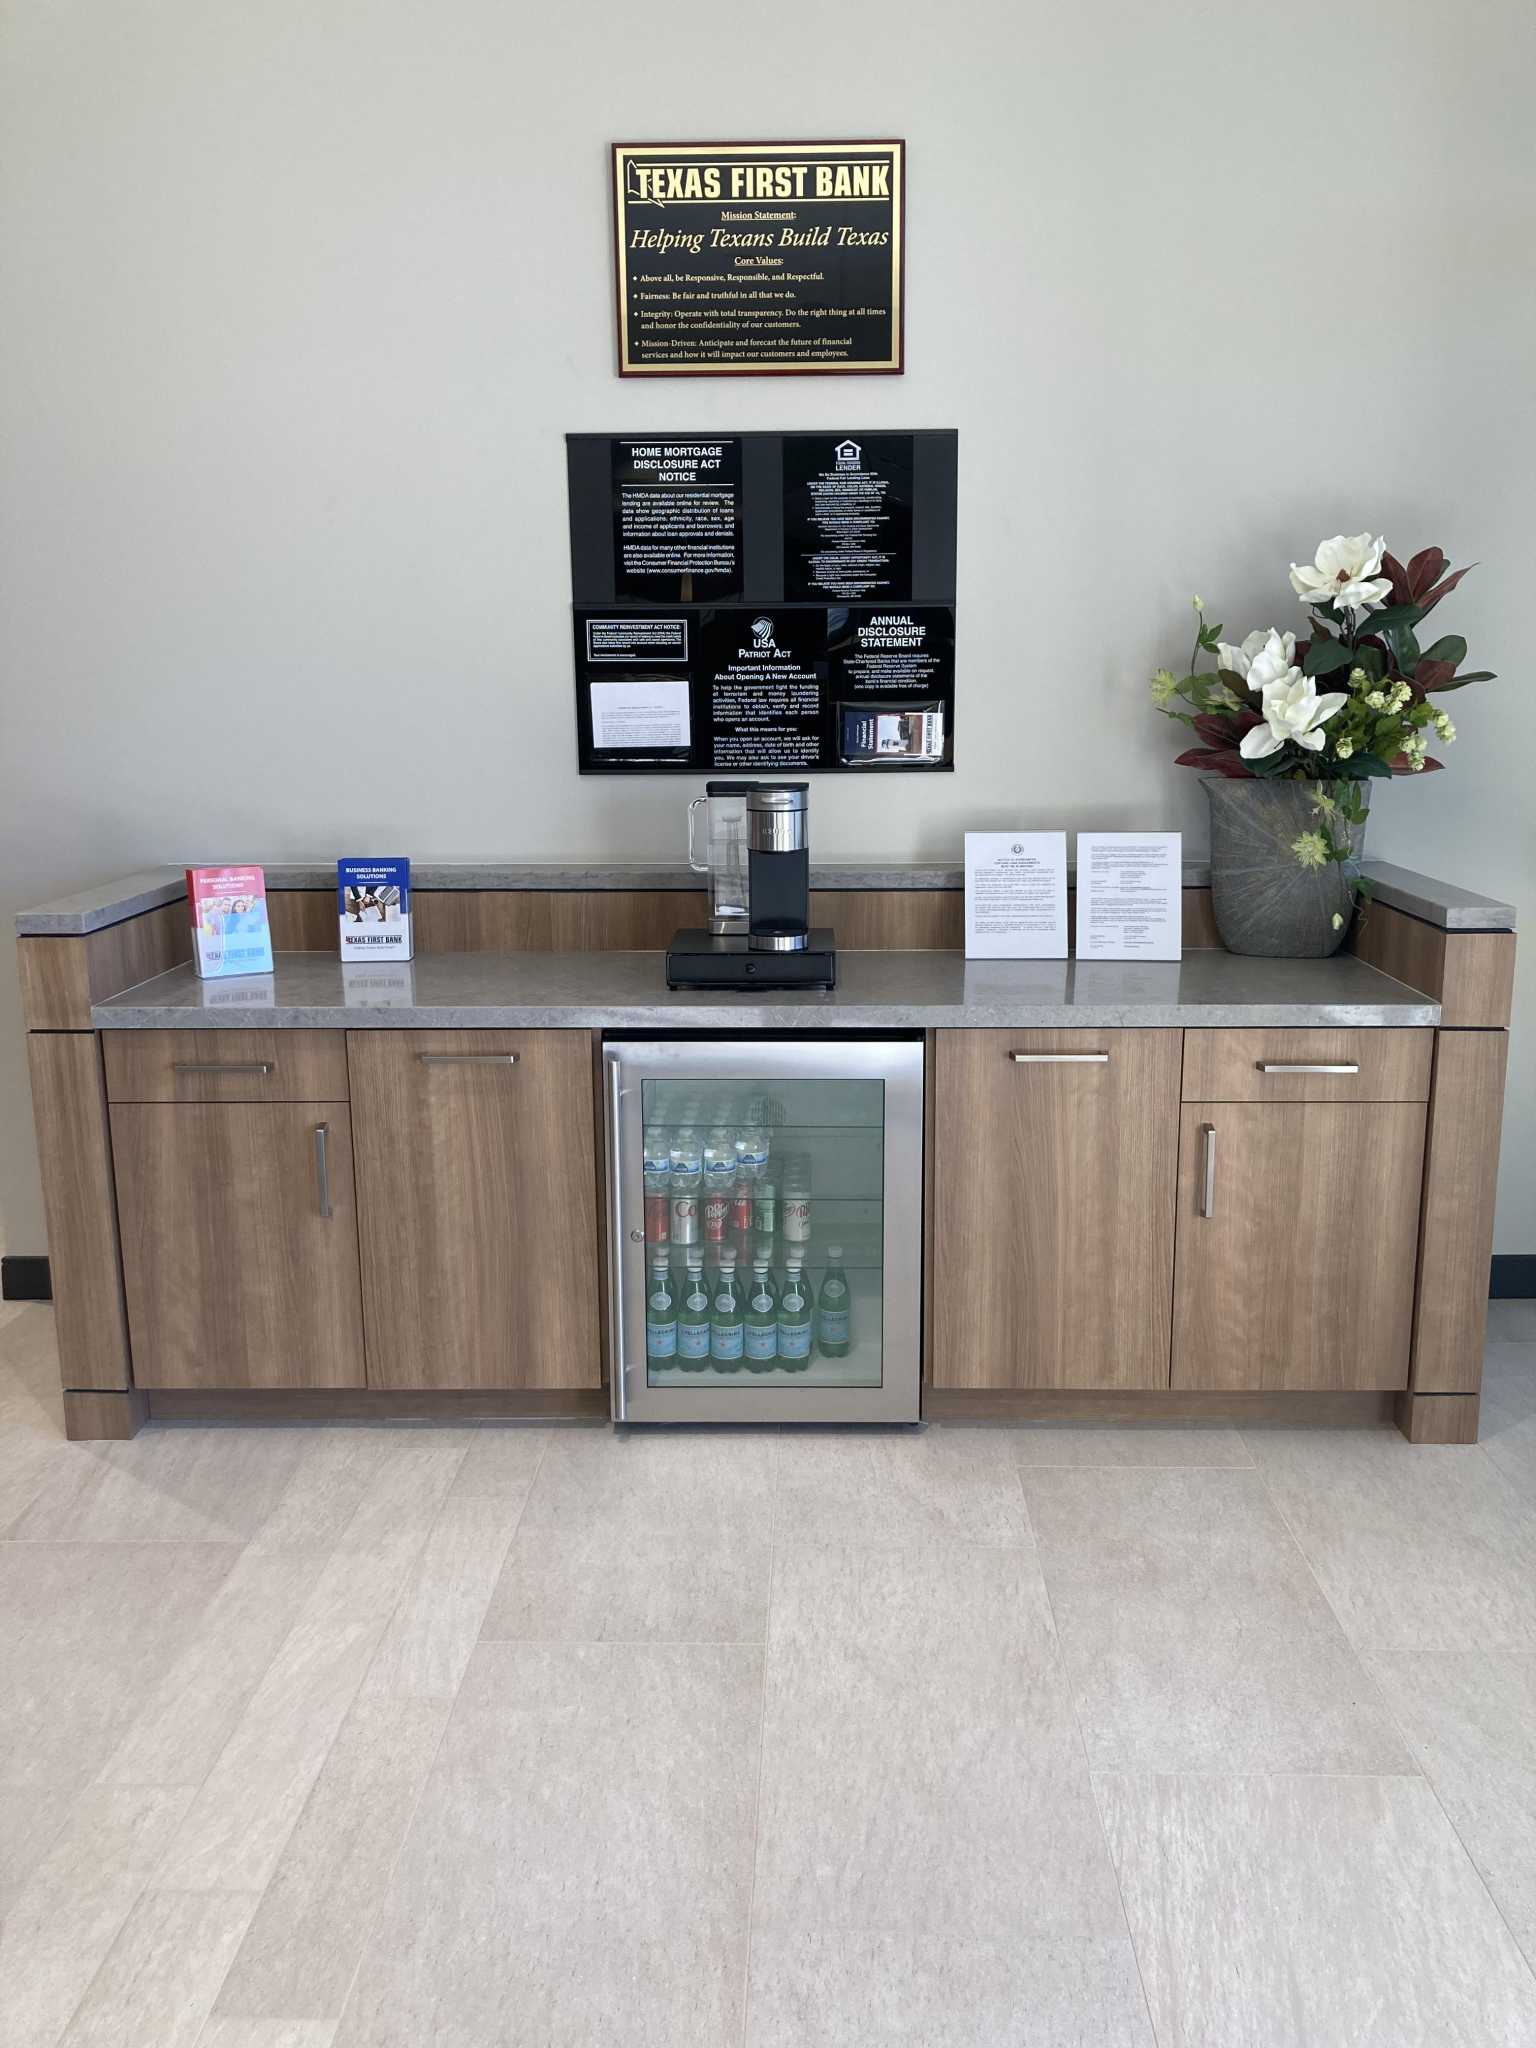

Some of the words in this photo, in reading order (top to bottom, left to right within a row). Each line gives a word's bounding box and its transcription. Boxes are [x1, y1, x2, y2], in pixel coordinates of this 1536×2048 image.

[636, 168, 720, 198] TEXAS
[731, 167, 808, 198] FIRST
[816, 166, 890, 197] BANK
[721, 211, 752, 220] Mission
[754, 211, 796, 220] Statement:
[630, 229, 704, 253] Helping
[710, 228, 773, 248] Texans
[778, 227, 830, 246] Build
[837, 226, 888, 246] Texas
[756, 256, 783, 264] Values:
[685, 274, 725, 282] Responsive,
[727, 273, 770, 282] Responsible,
[786, 272, 824, 282] Respectful.
[674, 310, 701, 319] Operate
[737, 310, 783, 318] transparency.
[810, 308, 826, 317] right
[828, 308, 847, 317] thing
[690, 321, 740, 330] confidentiality
[698, 339, 734, 347] Anticipate
[811, 350, 848, 358] employees.
[632, 448, 661, 456] HOME
[664, 447, 721, 456] MORTGAGE
[634, 460, 697, 468] DISCLOSURE
[700, 459, 720, 468] ACT
[659, 472, 696, 481] NOTICE
[870, 616, 914, 626] ANNUAL
[858, 627, 926, 636] DISCLOSURE
[753, 639, 776, 648] USA
[861, 638, 923, 647] STATEMENT
